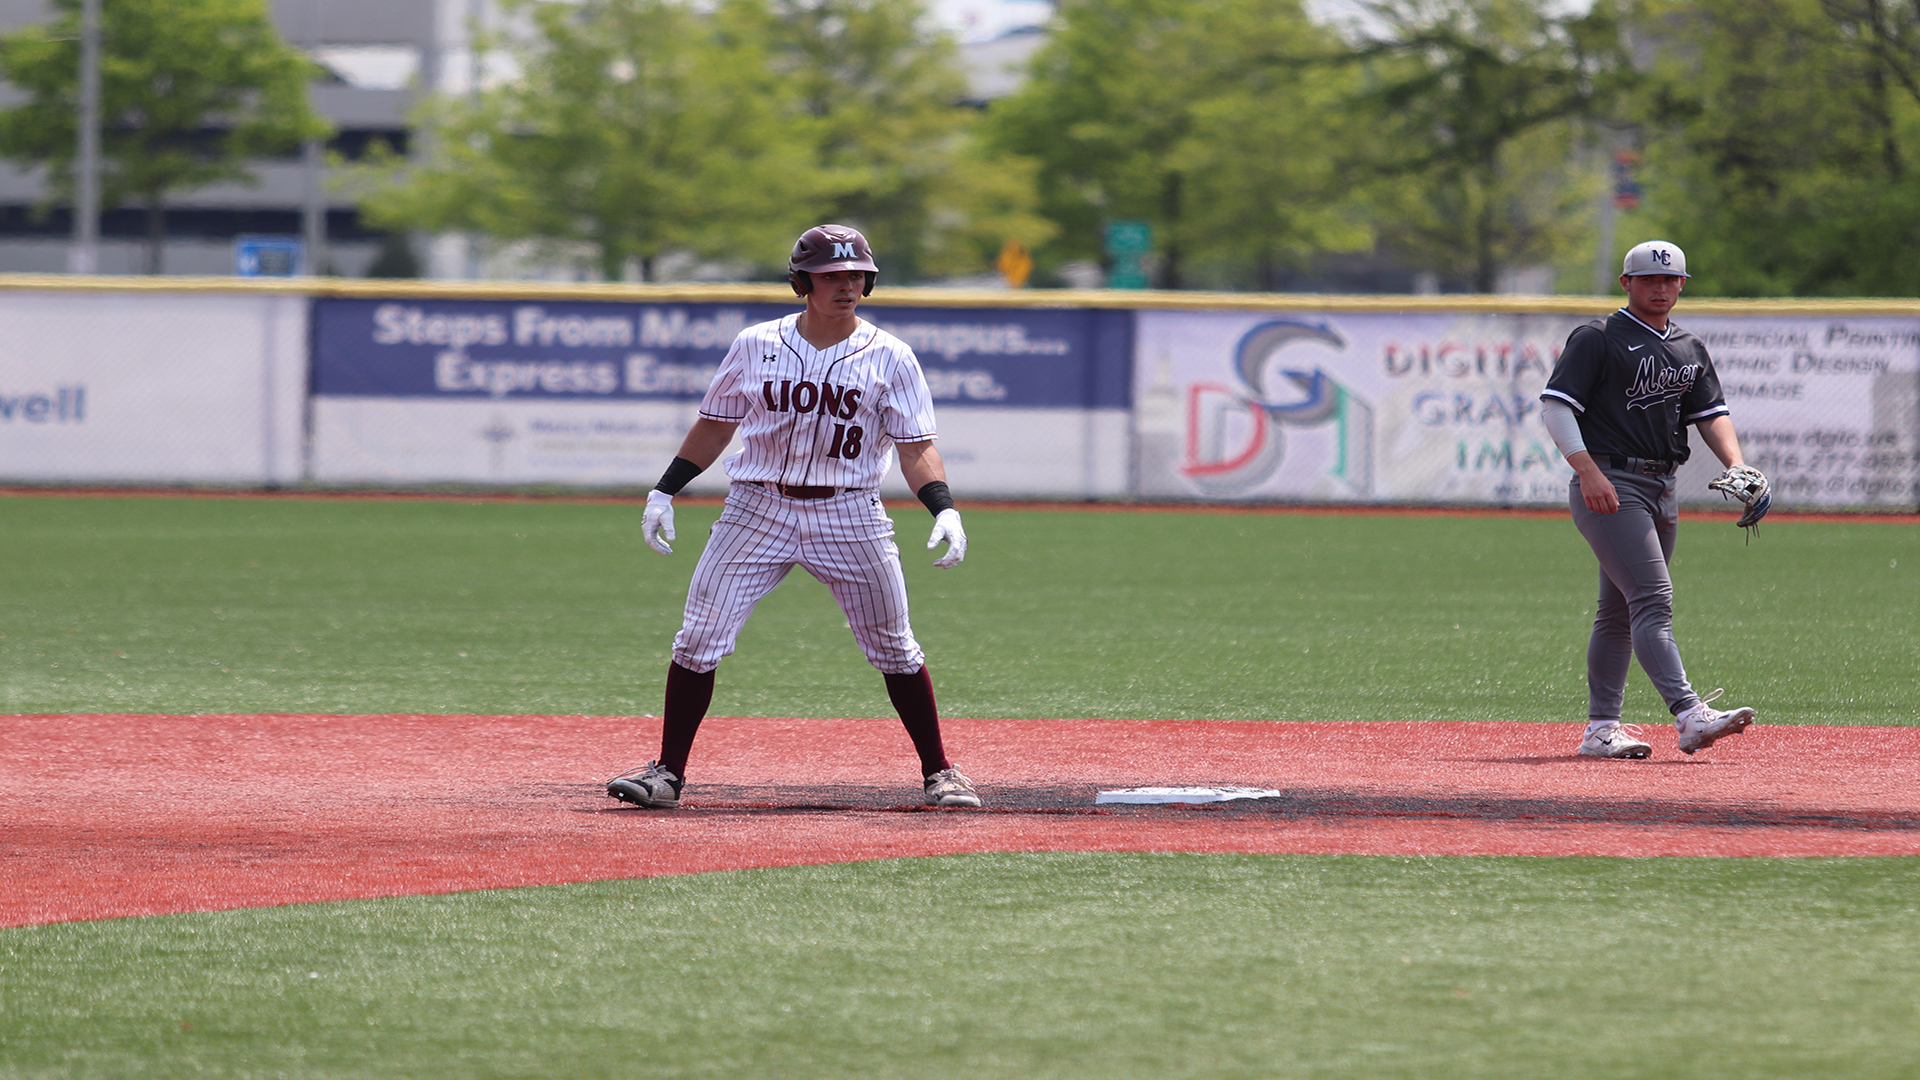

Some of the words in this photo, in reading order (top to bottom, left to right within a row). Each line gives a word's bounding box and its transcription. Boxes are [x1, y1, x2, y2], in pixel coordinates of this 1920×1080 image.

[831, 242, 858, 259] M
[1651, 249, 1672, 266] MC
[372, 304, 507, 350] Steps
[513, 306, 633, 348] From
[640, 309, 762, 349] Moll
[435, 351, 618, 398] Express
[924, 367, 1006, 399] are.
[1722, 383, 1806, 401] GNAGE
[763, 380, 862, 420] LIONS
[1413, 391, 1542, 426] GRAP
[826, 423, 863, 459] 18
[1456, 438, 1562, 471] IMA
